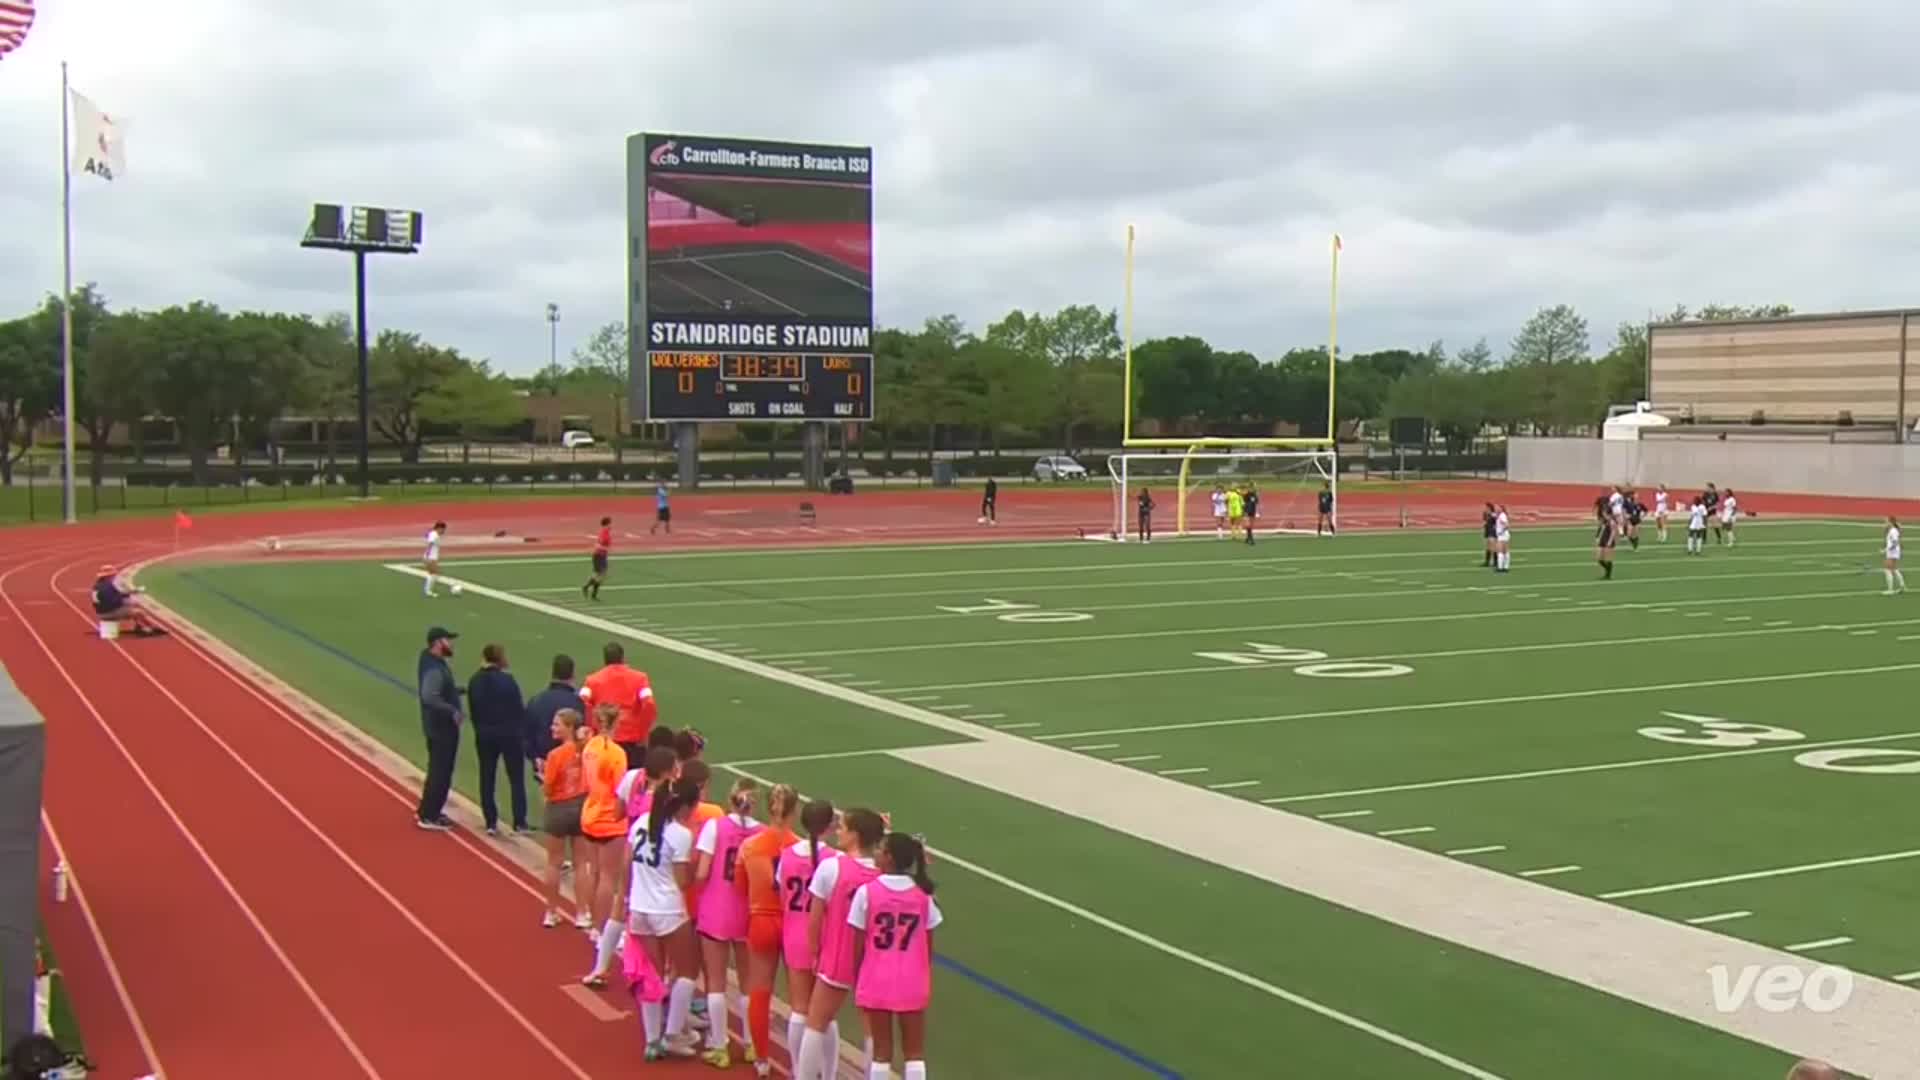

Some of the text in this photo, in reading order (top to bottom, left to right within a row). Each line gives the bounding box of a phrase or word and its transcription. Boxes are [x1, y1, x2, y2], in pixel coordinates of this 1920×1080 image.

[683, 146, 869, 173] Carrollton-Farmers Branch ISD
[651, 322, 870, 348] STANDRIDGE STADIUM
[678, 372, 693, 393] 0
[847, 373, 861, 395] 0
[728, 402, 756, 416] SHOTS
[632, 828, 661, 868] 23
[873, 911, 920, 951] 37
